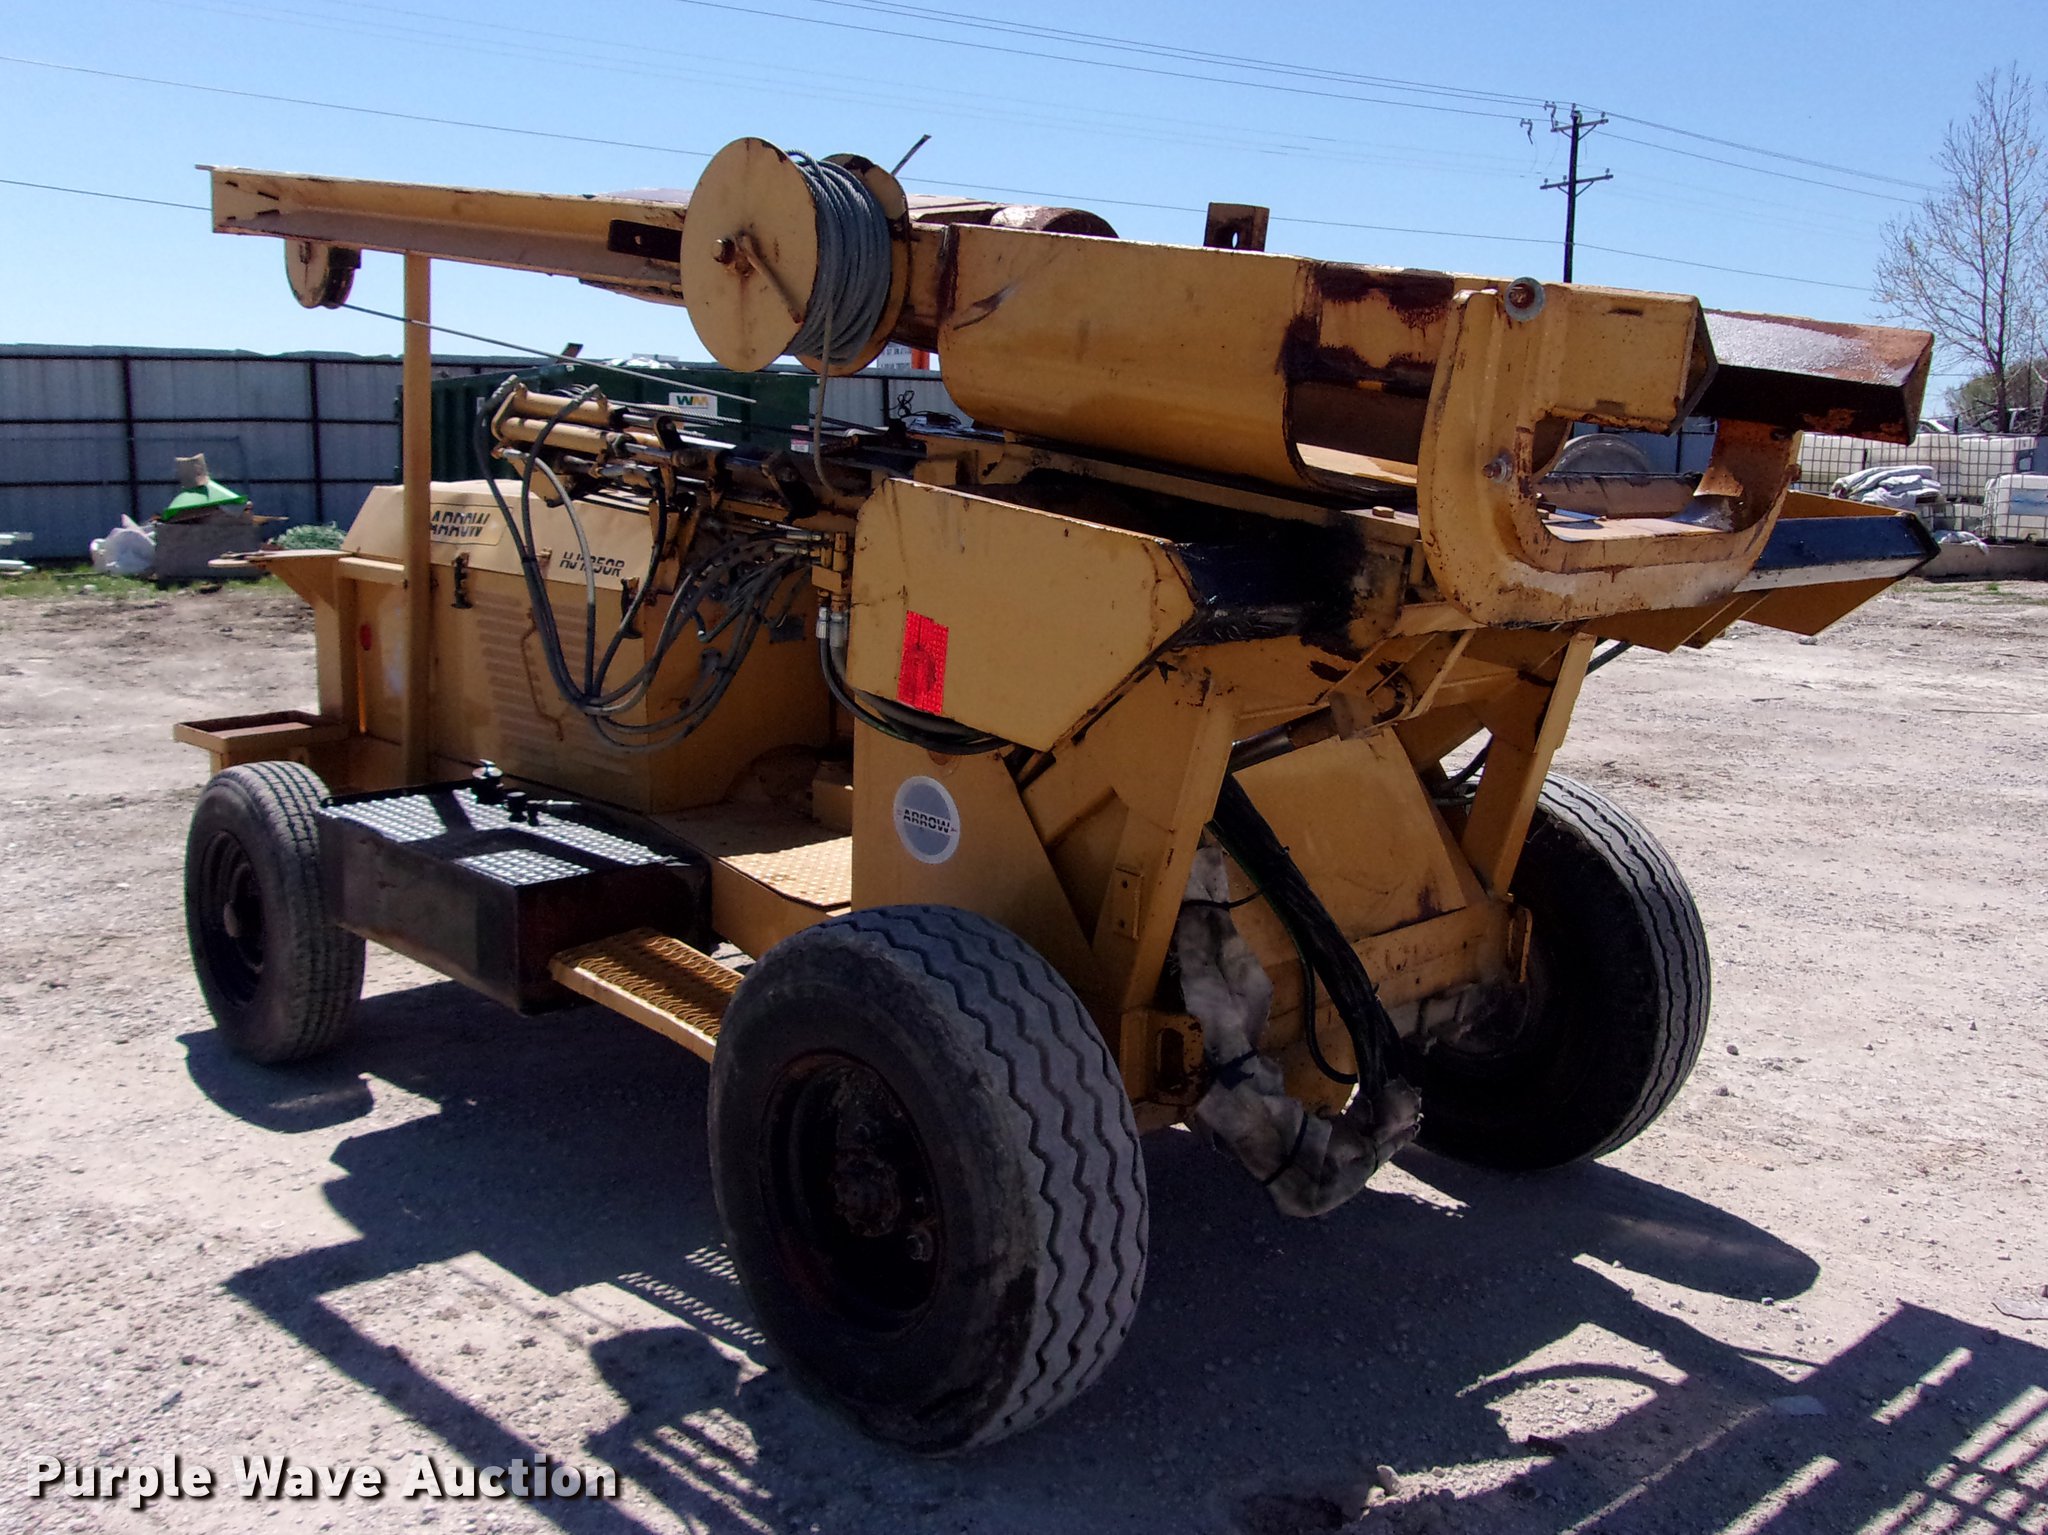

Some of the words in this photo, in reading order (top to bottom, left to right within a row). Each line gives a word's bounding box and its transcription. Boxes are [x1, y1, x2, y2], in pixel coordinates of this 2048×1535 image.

[676, 395, 709, 406] WM
[431, 510, 491, 537] ARROW
[903, 808, 951, 834] ARROW
